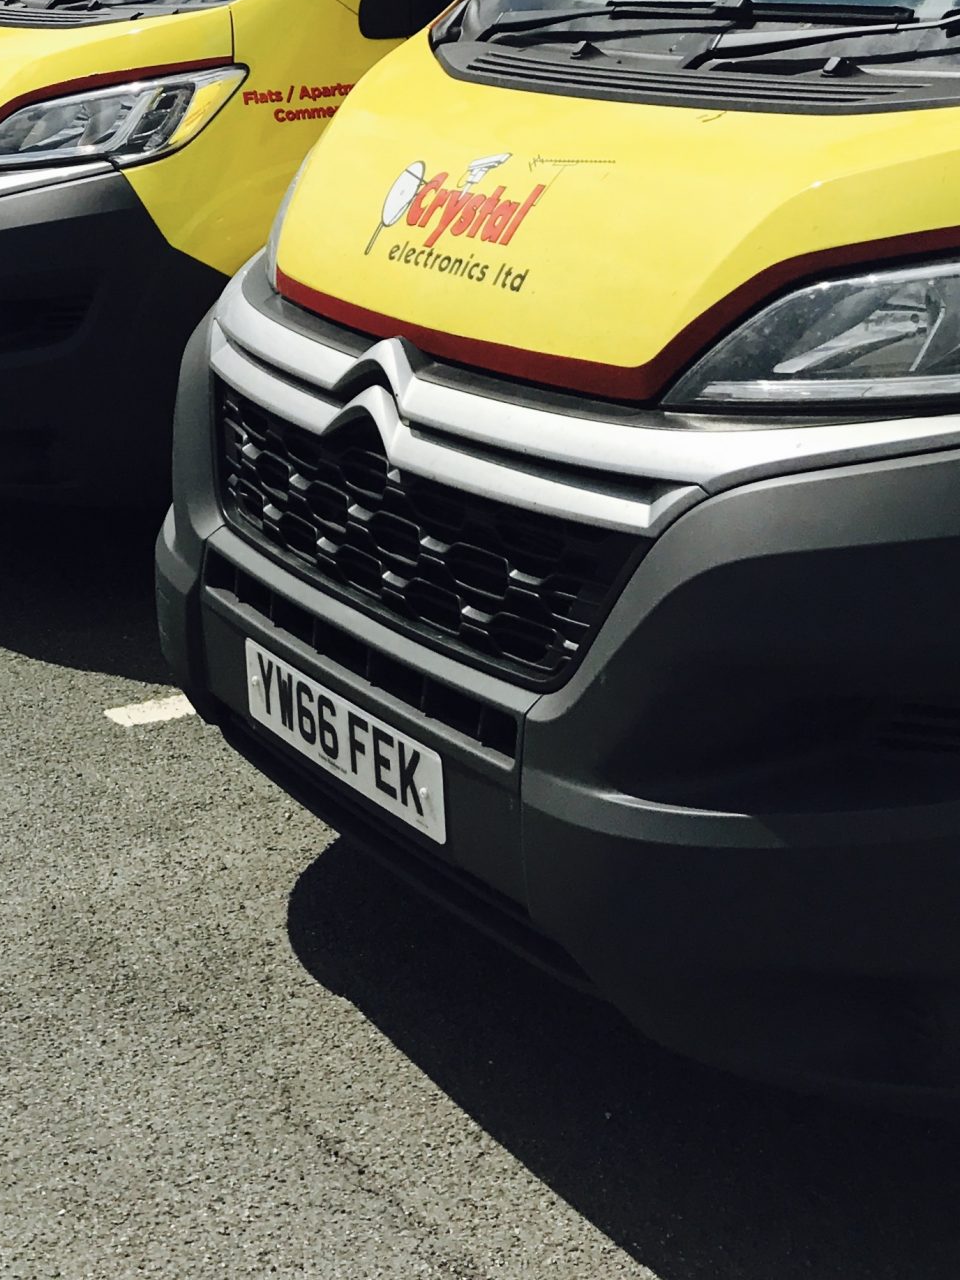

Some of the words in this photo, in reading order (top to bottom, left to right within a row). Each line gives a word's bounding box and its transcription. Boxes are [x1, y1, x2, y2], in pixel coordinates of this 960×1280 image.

[243, 90, 283, 105] Flats
[287, 85, 294, 103] /
[406, 171, 546, 248] Crystal
[388, 241, 489, 282] electronics
[492, 263, 530, 292] ltd
[257, 652, 339, 760] YW66
[347, 710, 424, 817] FEK
